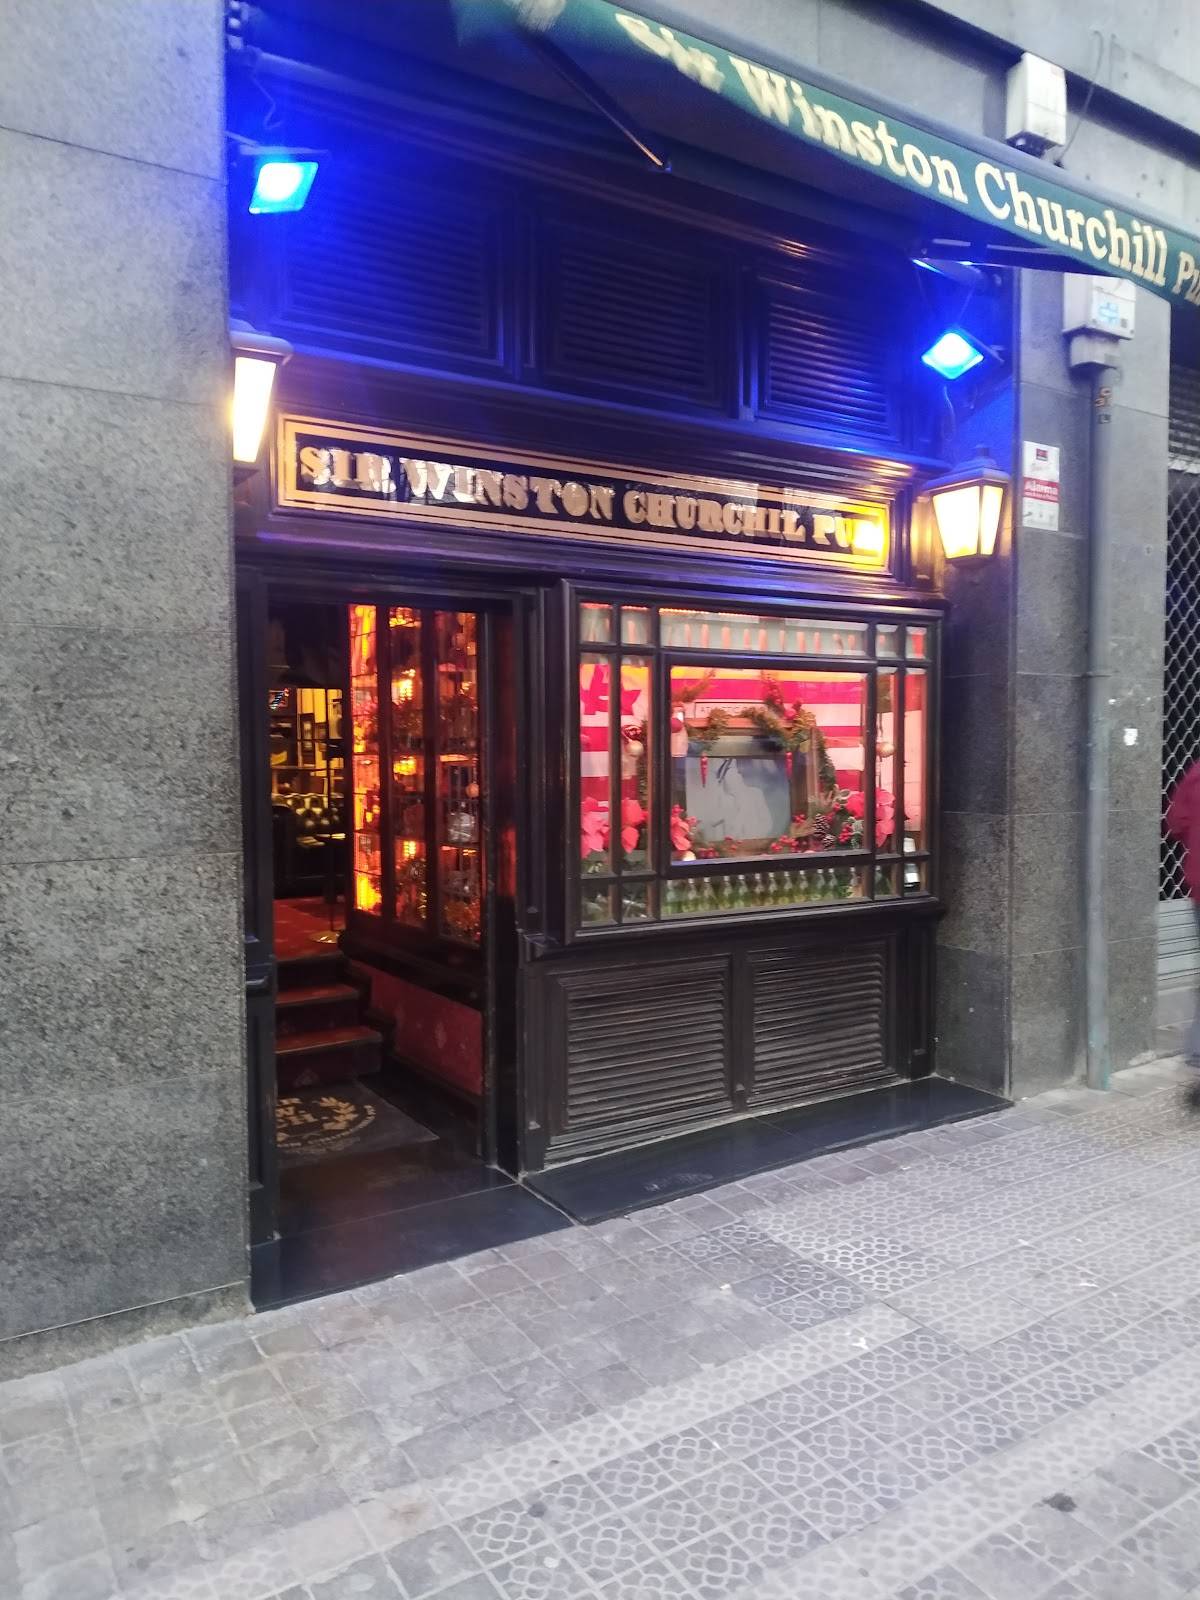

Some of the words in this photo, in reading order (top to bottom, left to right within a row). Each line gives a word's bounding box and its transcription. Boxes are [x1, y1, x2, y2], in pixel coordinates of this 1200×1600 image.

[728, 55, 968, 204] Winston
[974, 163, 1167, 288] Churchill
[399, 457, 616, 521] WINSTON
